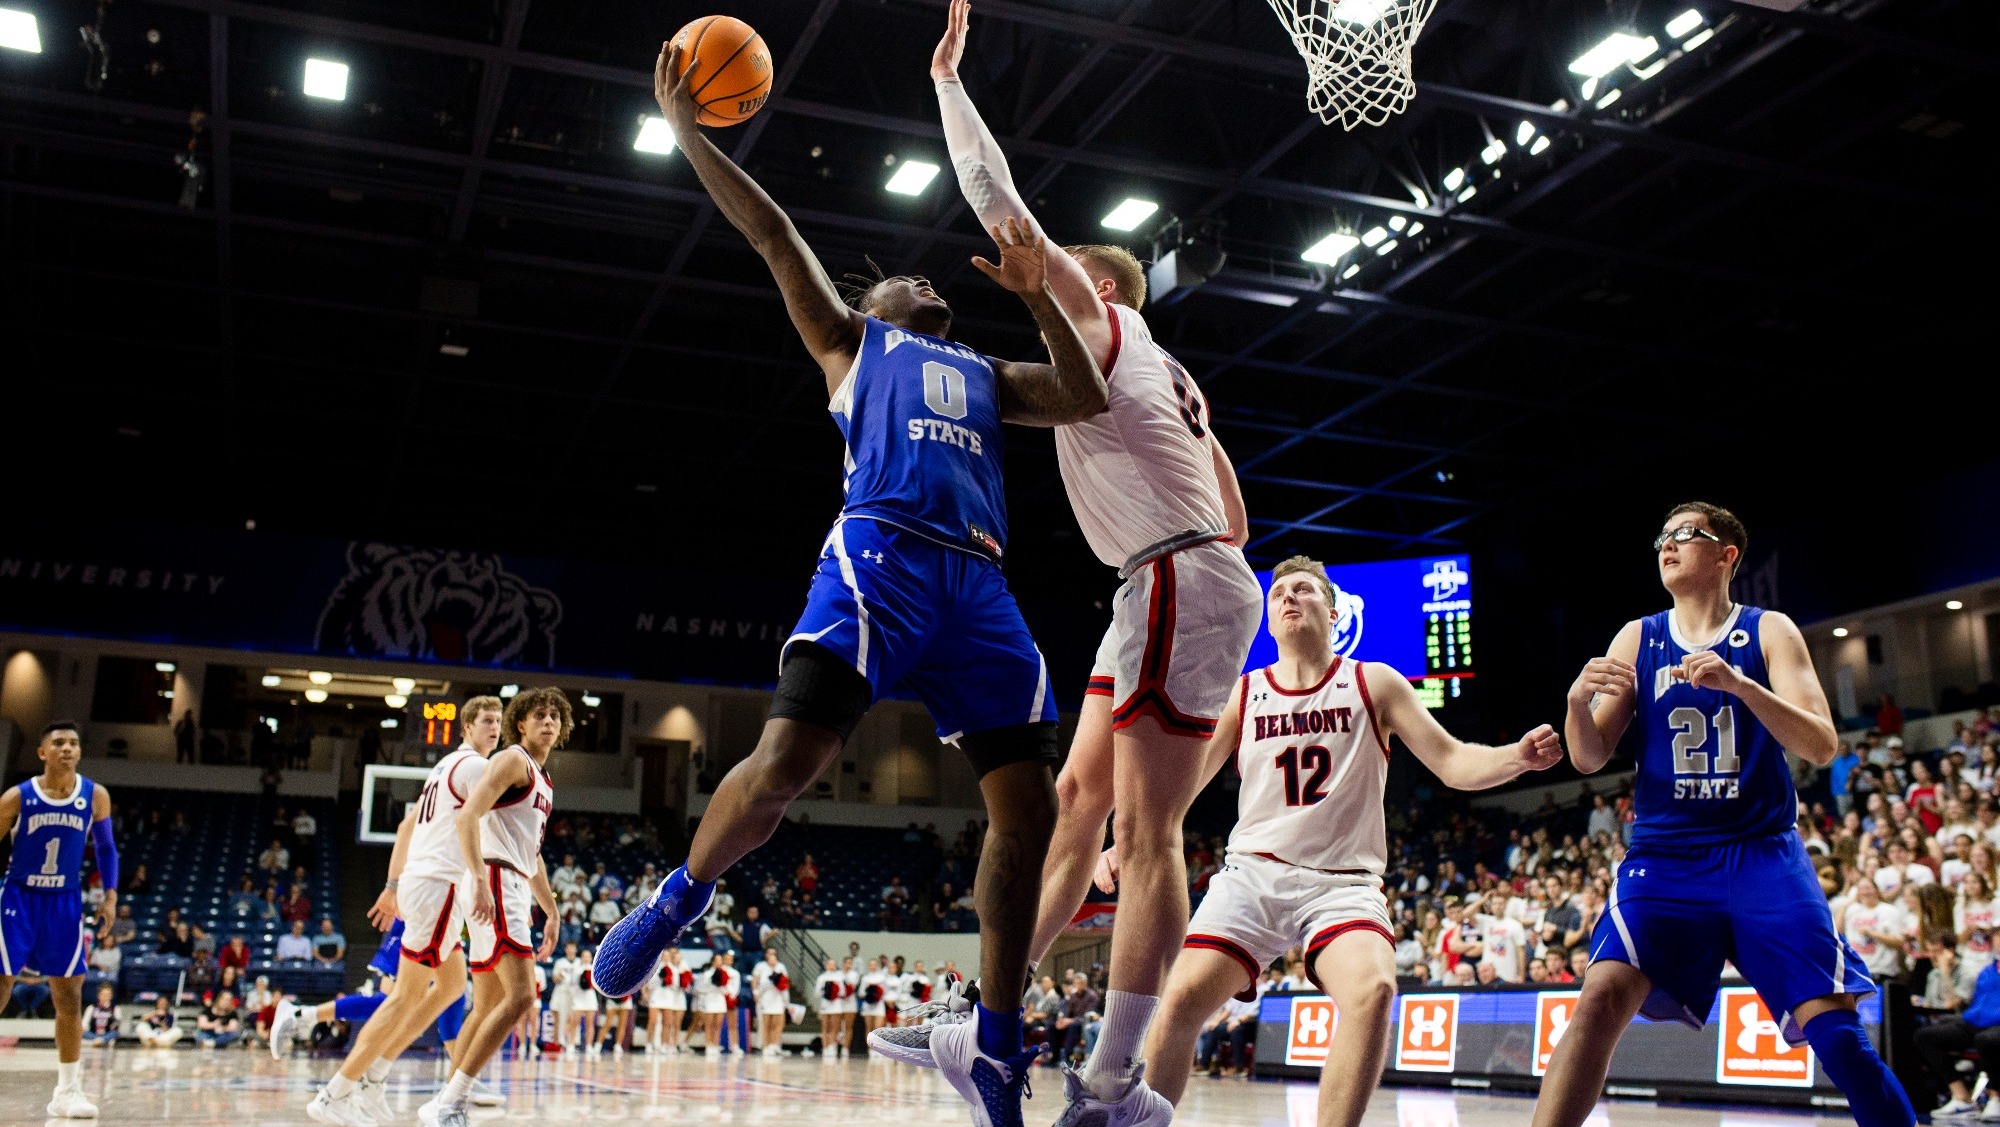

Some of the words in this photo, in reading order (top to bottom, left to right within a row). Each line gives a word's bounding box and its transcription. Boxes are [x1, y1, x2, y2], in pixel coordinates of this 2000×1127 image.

[922, 360, 967, 420] 0
[908, 418, 982, 456] STATE
[426, 720, 450, 745] 11
[1254, 707, 1352, 742] BELMONT
[1668, 705, 1740, 774] 21
[1275, 745, 1332, 806] 12
[1674, 777, 1740, 800] STATE
[27, 812, 84, 836] INDIANA
[41, 837, 60, 875] 1
[26, 874, 66, 888] STATE
